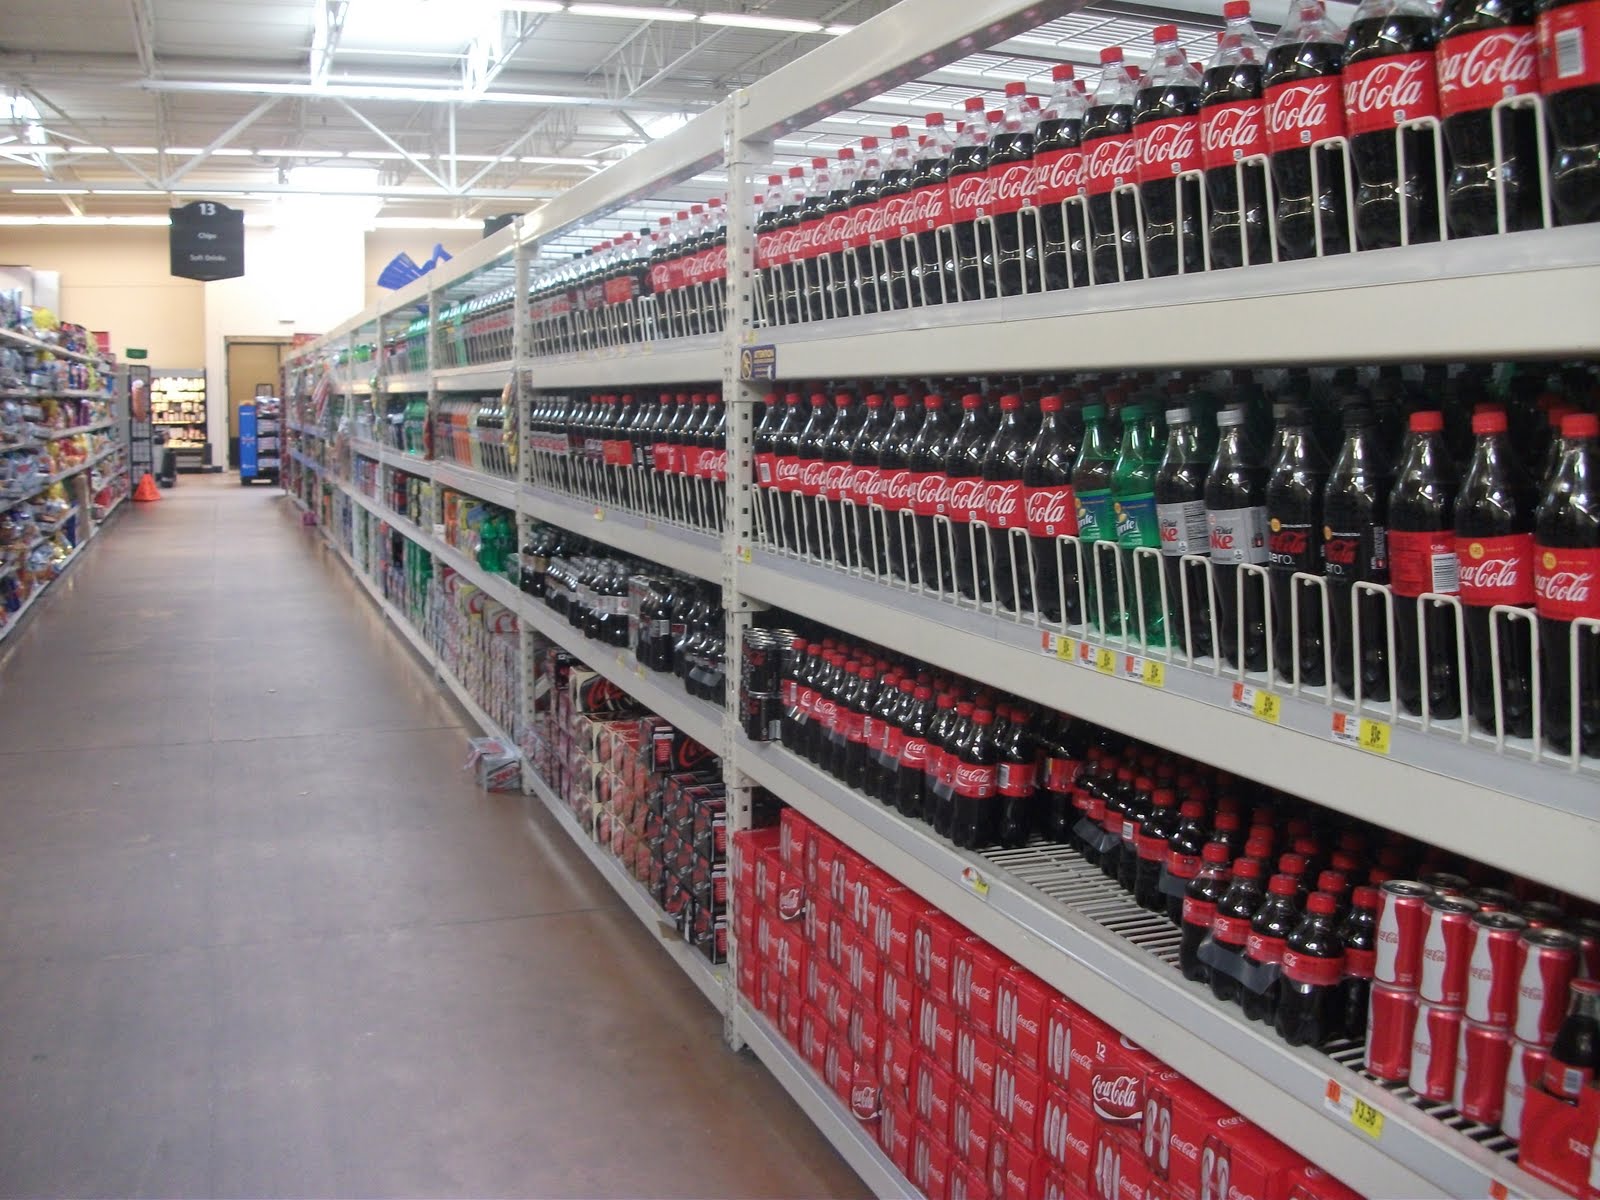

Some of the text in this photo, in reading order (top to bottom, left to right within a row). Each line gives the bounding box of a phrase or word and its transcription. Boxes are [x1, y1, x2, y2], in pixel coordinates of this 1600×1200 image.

[198, 203, 217, 216] 13
[198, 232, 217, 240] Chips
[1096, 1041, 1106, 1058] 12
[1092, 1074, 1140, 1107] Coca-Cola
